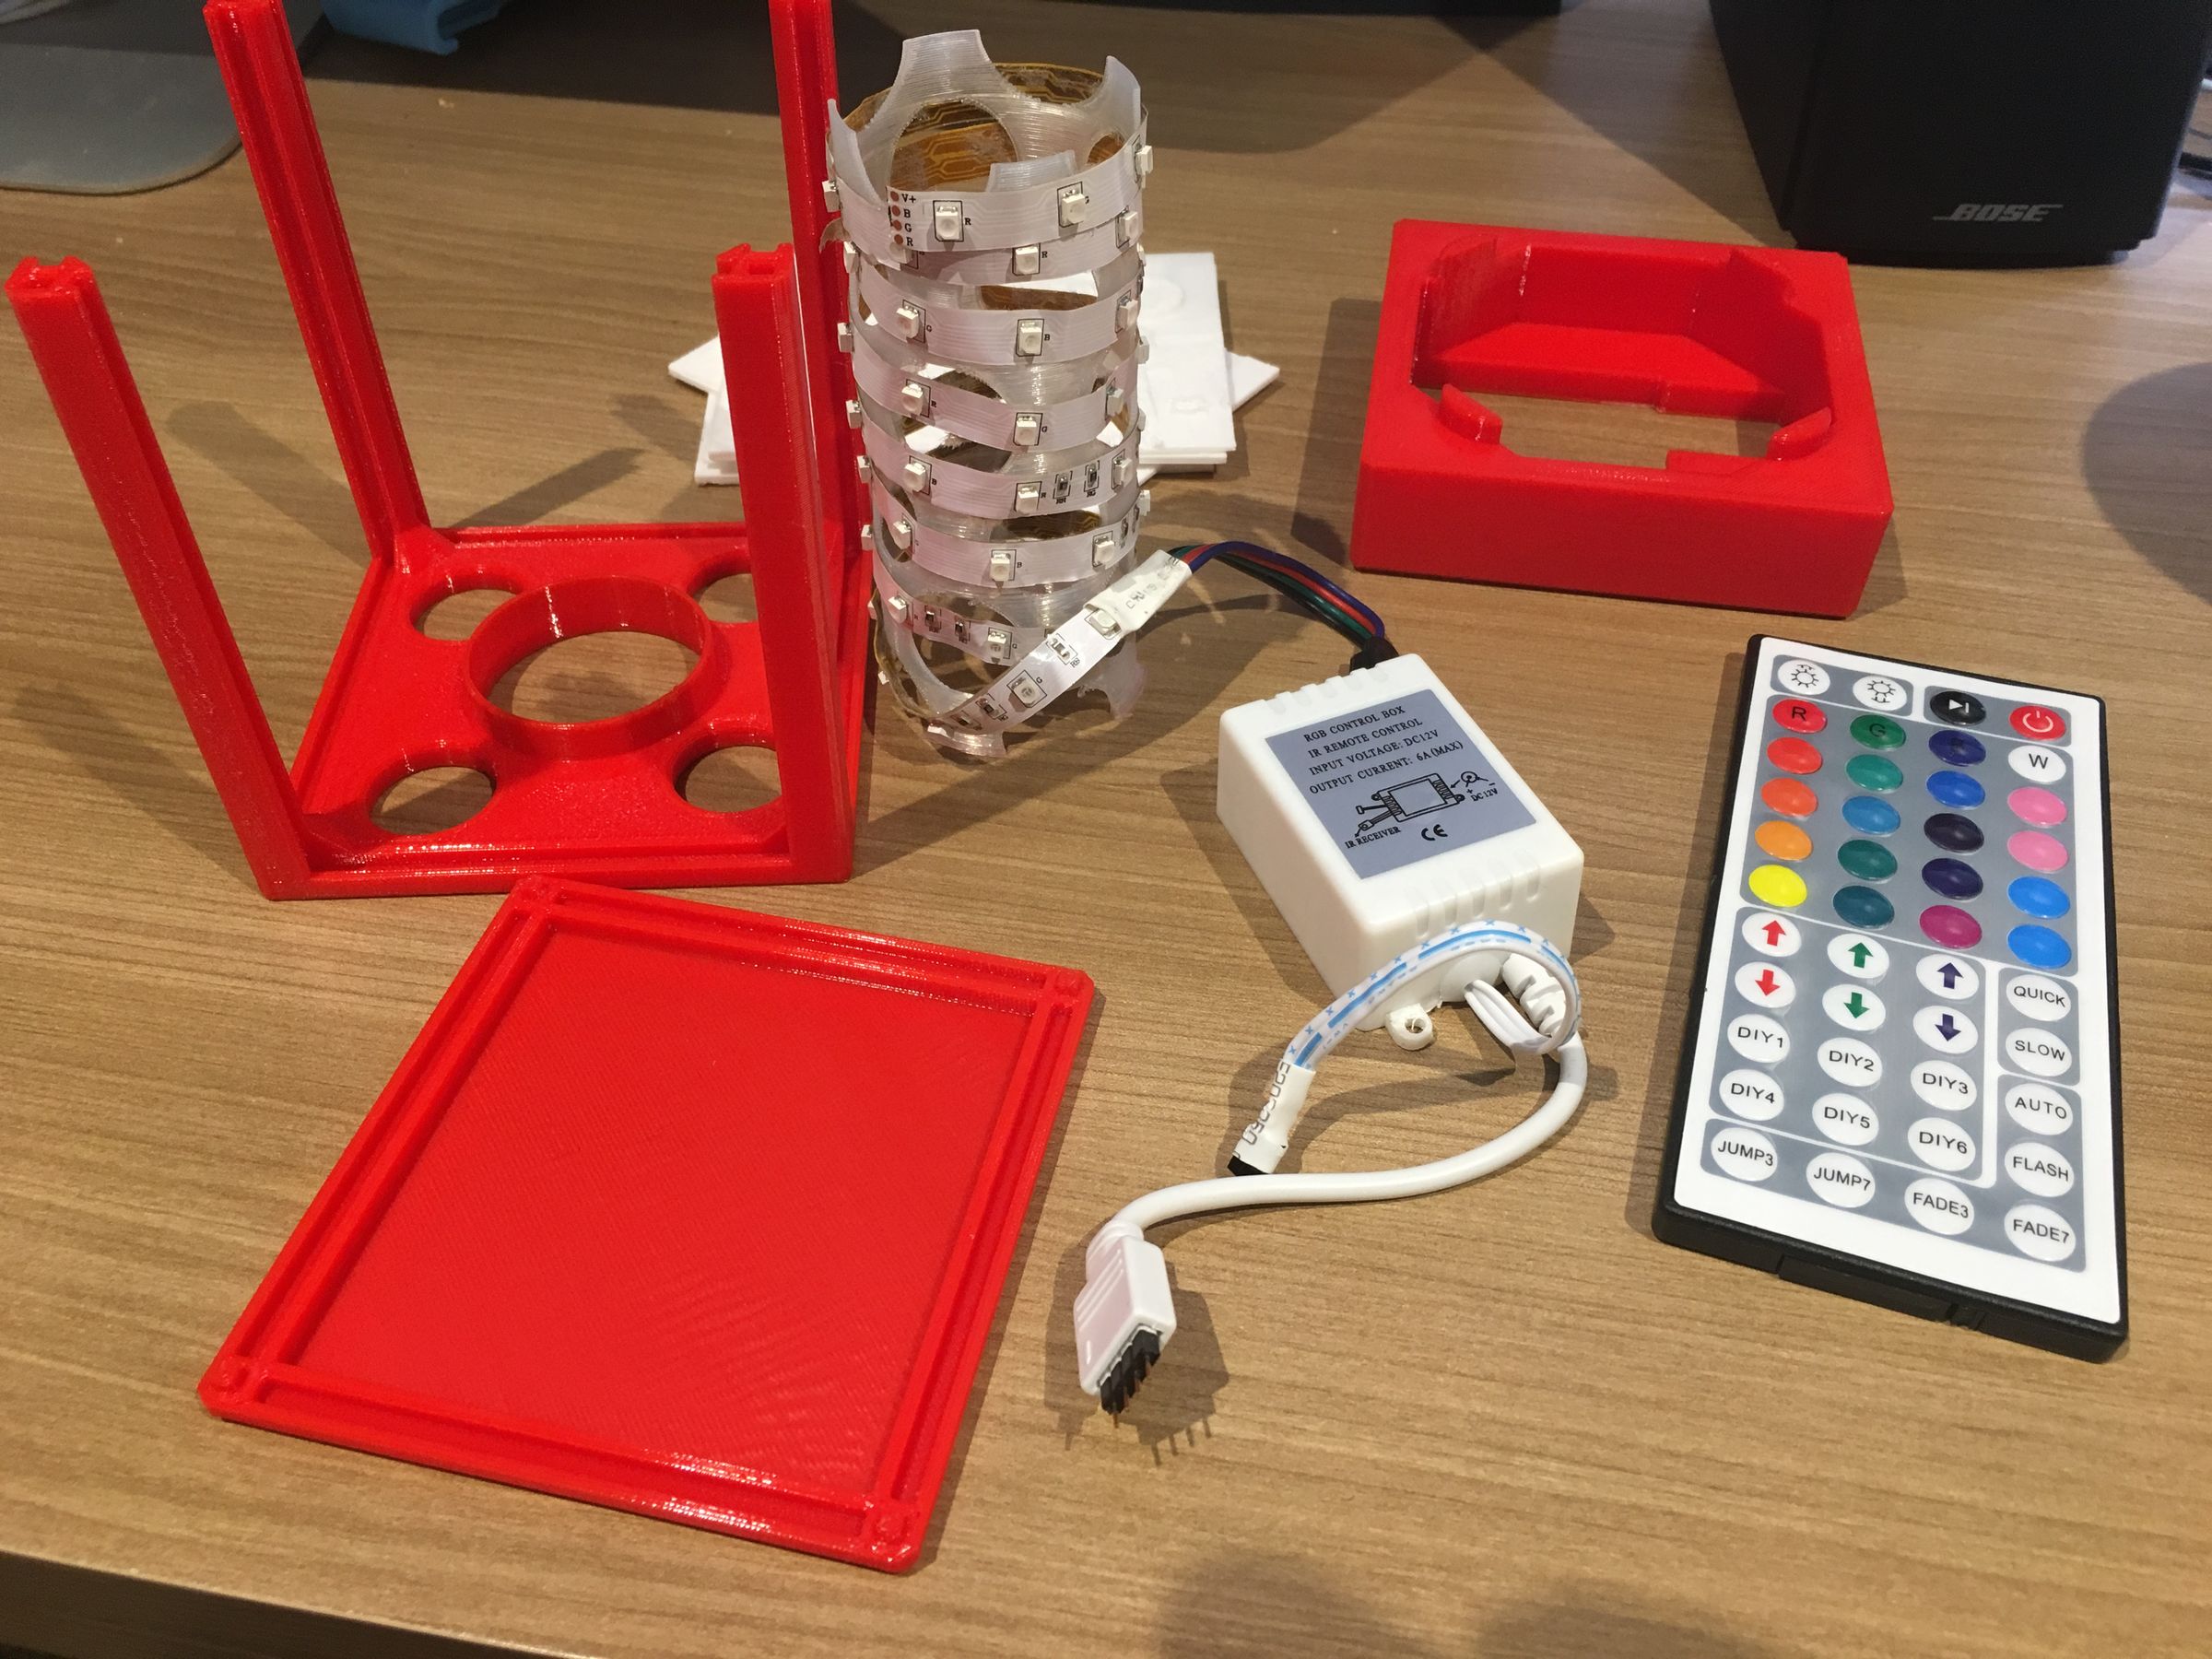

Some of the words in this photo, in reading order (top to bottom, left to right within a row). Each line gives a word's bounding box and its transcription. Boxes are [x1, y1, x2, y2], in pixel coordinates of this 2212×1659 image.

[901, 194, 916, 204] V+
[903, 208, 911, 218] B
[964, 218, 971, 226] R
[1933, 204, 2064, 221] BOSE
[904, 223, 912, 232] G
[906, 237, 913, 246] R
[1303, 730, 1327, 742] RGB
[1329, 714, 1381, 734] CONTROL
[1381, 706, 1406, 718] BOX
[1792, 706, 1807, 721] R
[1308, 749, 1322, 759] IR
[1324, 734, 1370, 753] REMOTE
[1371, 718, 1423, 738] CONTROL
[1869, 724, 1885, 737] G
[1309, 759, 1344, 776] INPUT
[1347, 742, 1403, 763] VOLTAGE:
[2028, 754, 2049, 770] W
[1309, 774, 1354, 794] OUTPUT
[1357, 757, 1413, 780] CURRENT:
[1345, 840, 1356, 849] IR
[1356, 826, 1401, 846] RECEIVER
[2013, 985, 2066, 1008] QUICK
[1736, 1026, 1784, 1049] DIY1
[1829, 1050, 1875, 1072] DIY2
[2014, 1040, 2066, 1062] SLOW
[1730, 1082, 1775, 1104] DIY4
[1922, 1073, 1969, 1095] DIY3
[1824, 1106, 1870, 1129] DIY5
[2014, 1096, 2067, 1120] AUTO
[1717, 1140, 1774, 1167] JUMP3
[1919, 1131, 1968, 1154] DIY6
[1814, 1166, 1871, 1192] JUMP7
[2013, 1156, 2069, 1182] FLASH
[1912, 1192, 1970, 1219] FADE3
[2013, 1218, 2070, 1244] FADE7
